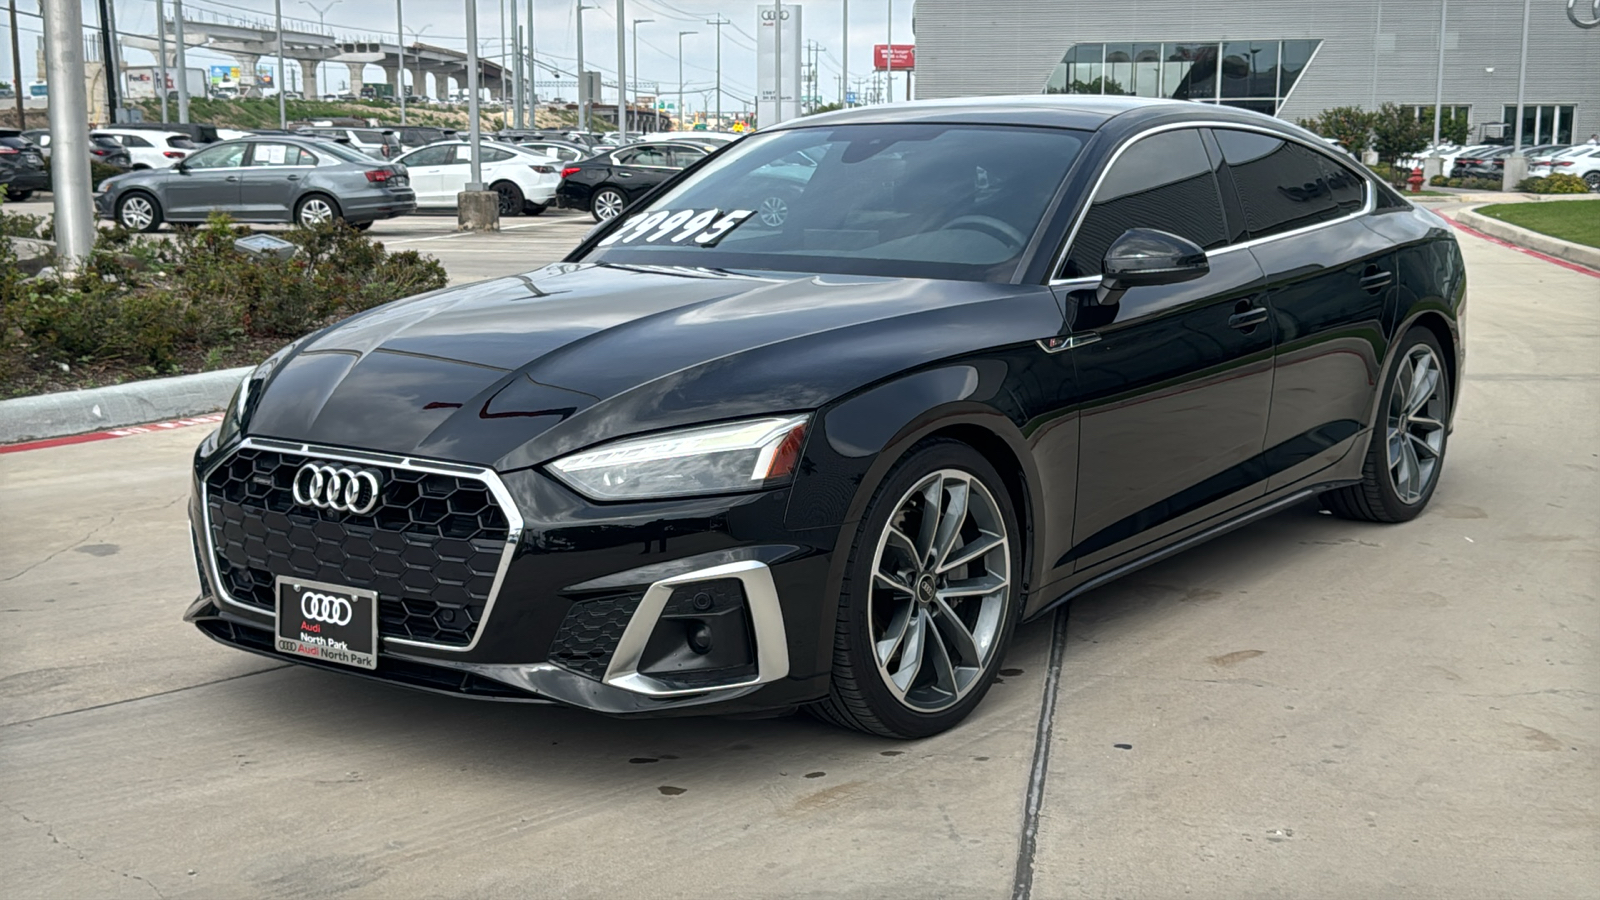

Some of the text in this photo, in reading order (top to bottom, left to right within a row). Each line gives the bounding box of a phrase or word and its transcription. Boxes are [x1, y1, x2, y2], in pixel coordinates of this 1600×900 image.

[598, 208, 753, 246] 29995
[301, 621, 320, 633] Audi
[300, 632, 348, 651] North Park
[298, 643, 372, 667] Audi North Park
